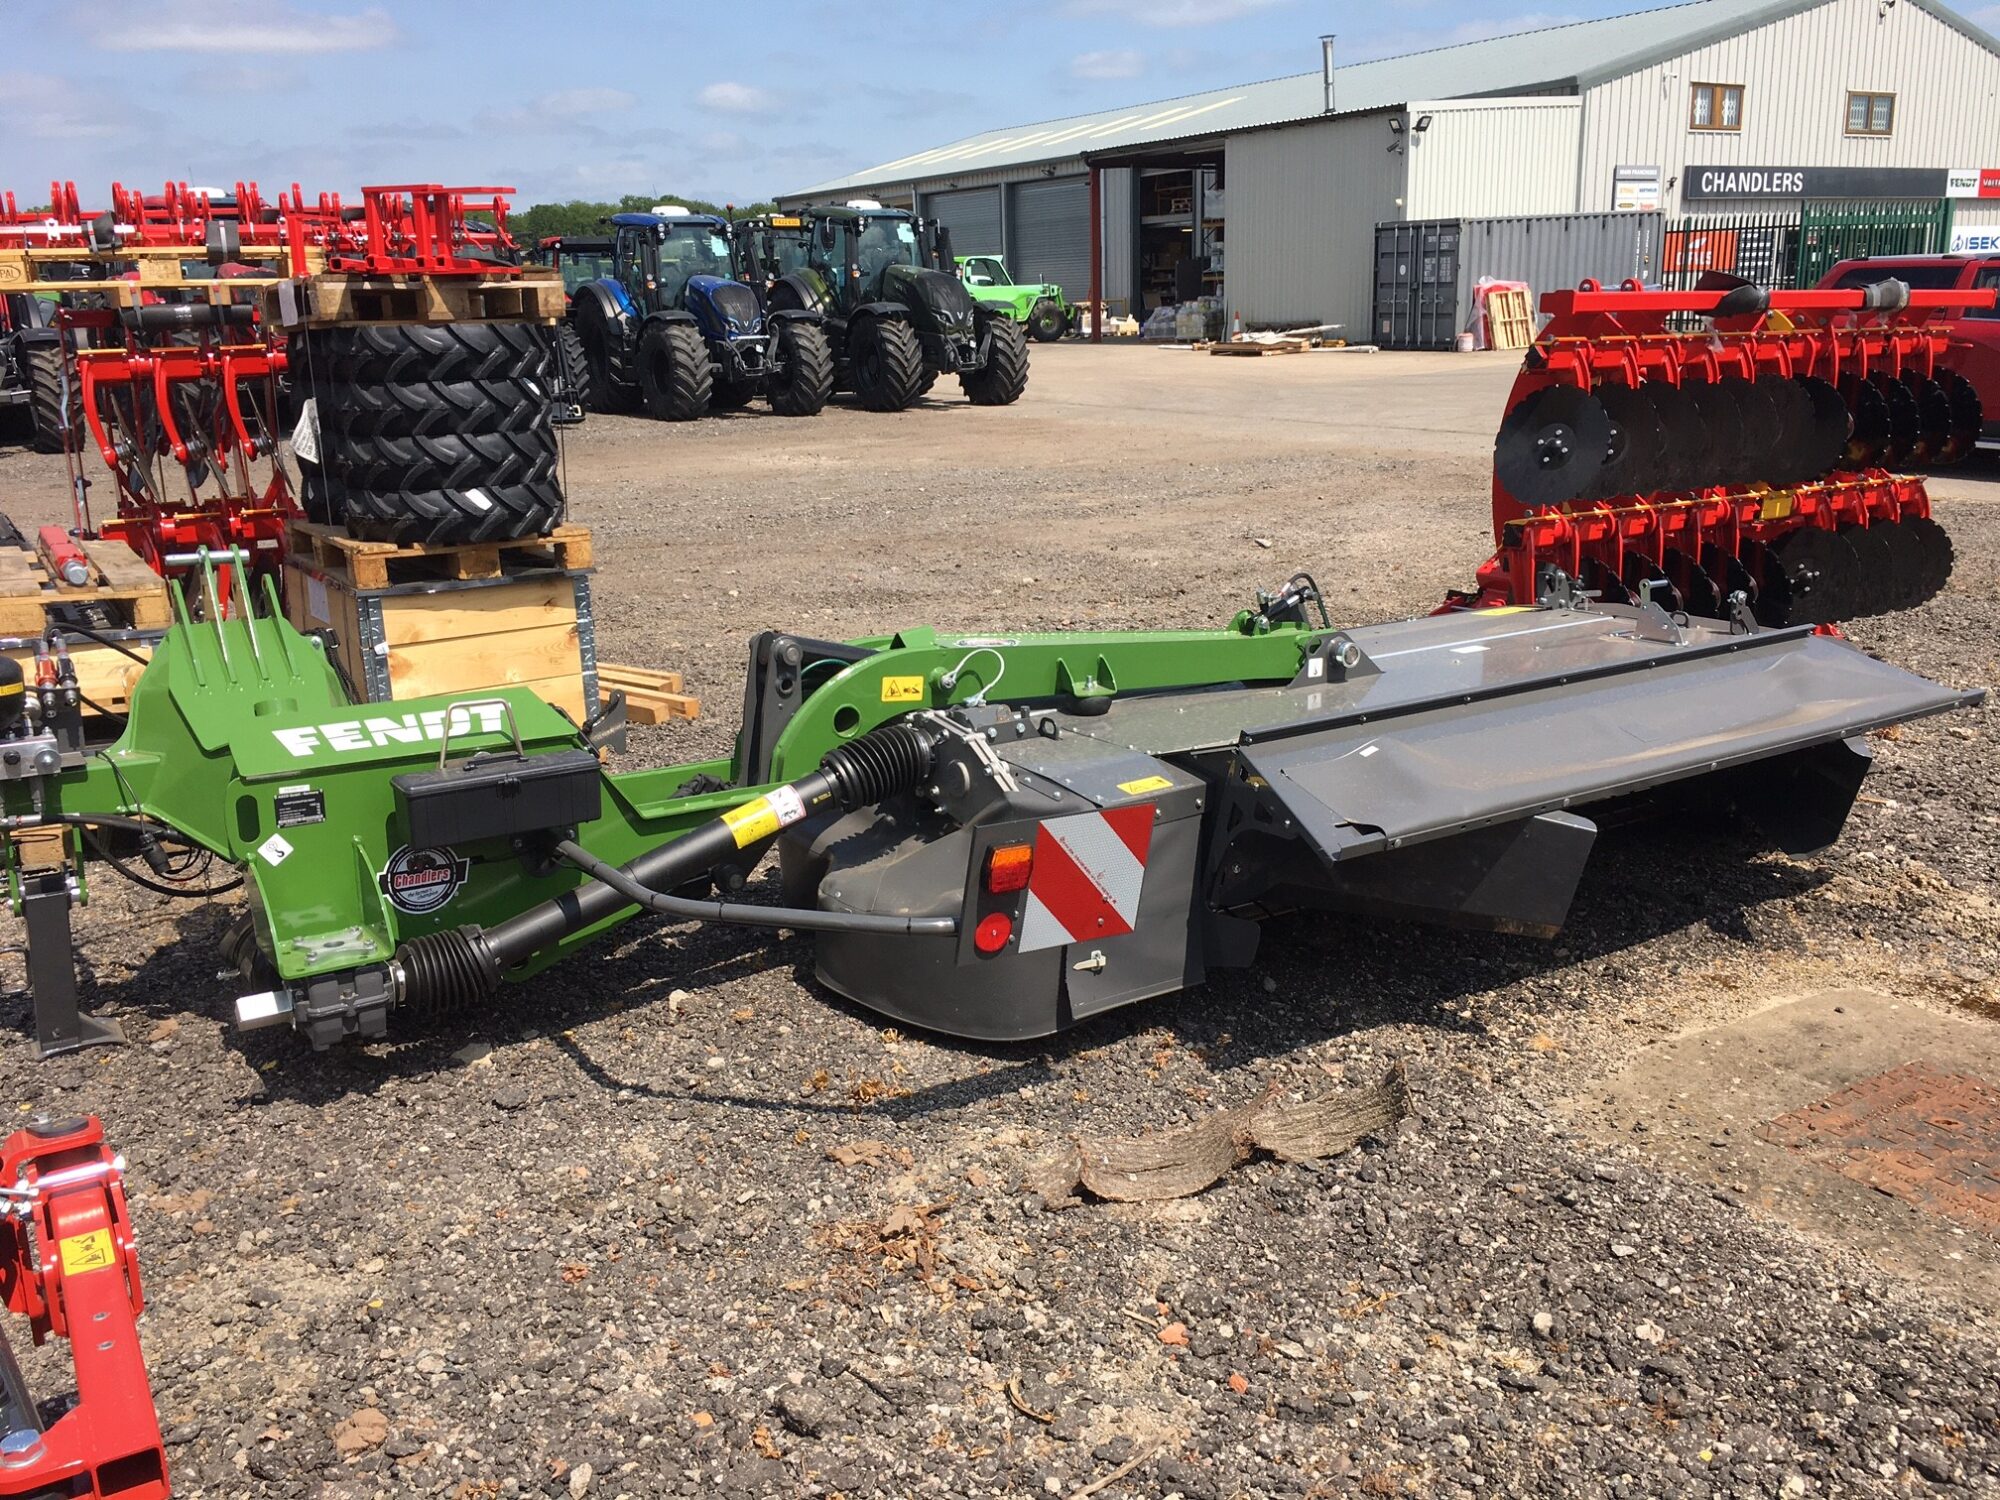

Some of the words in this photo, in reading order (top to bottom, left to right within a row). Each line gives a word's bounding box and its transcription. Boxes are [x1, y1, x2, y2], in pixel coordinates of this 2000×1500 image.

[1701, 171, 1804, 192] CHANDLERS
[1950, 178, 1977, 188] FENDT
[272, 702, 511, 757] FENDT
[394, 868, 451, 890] Chandlers
